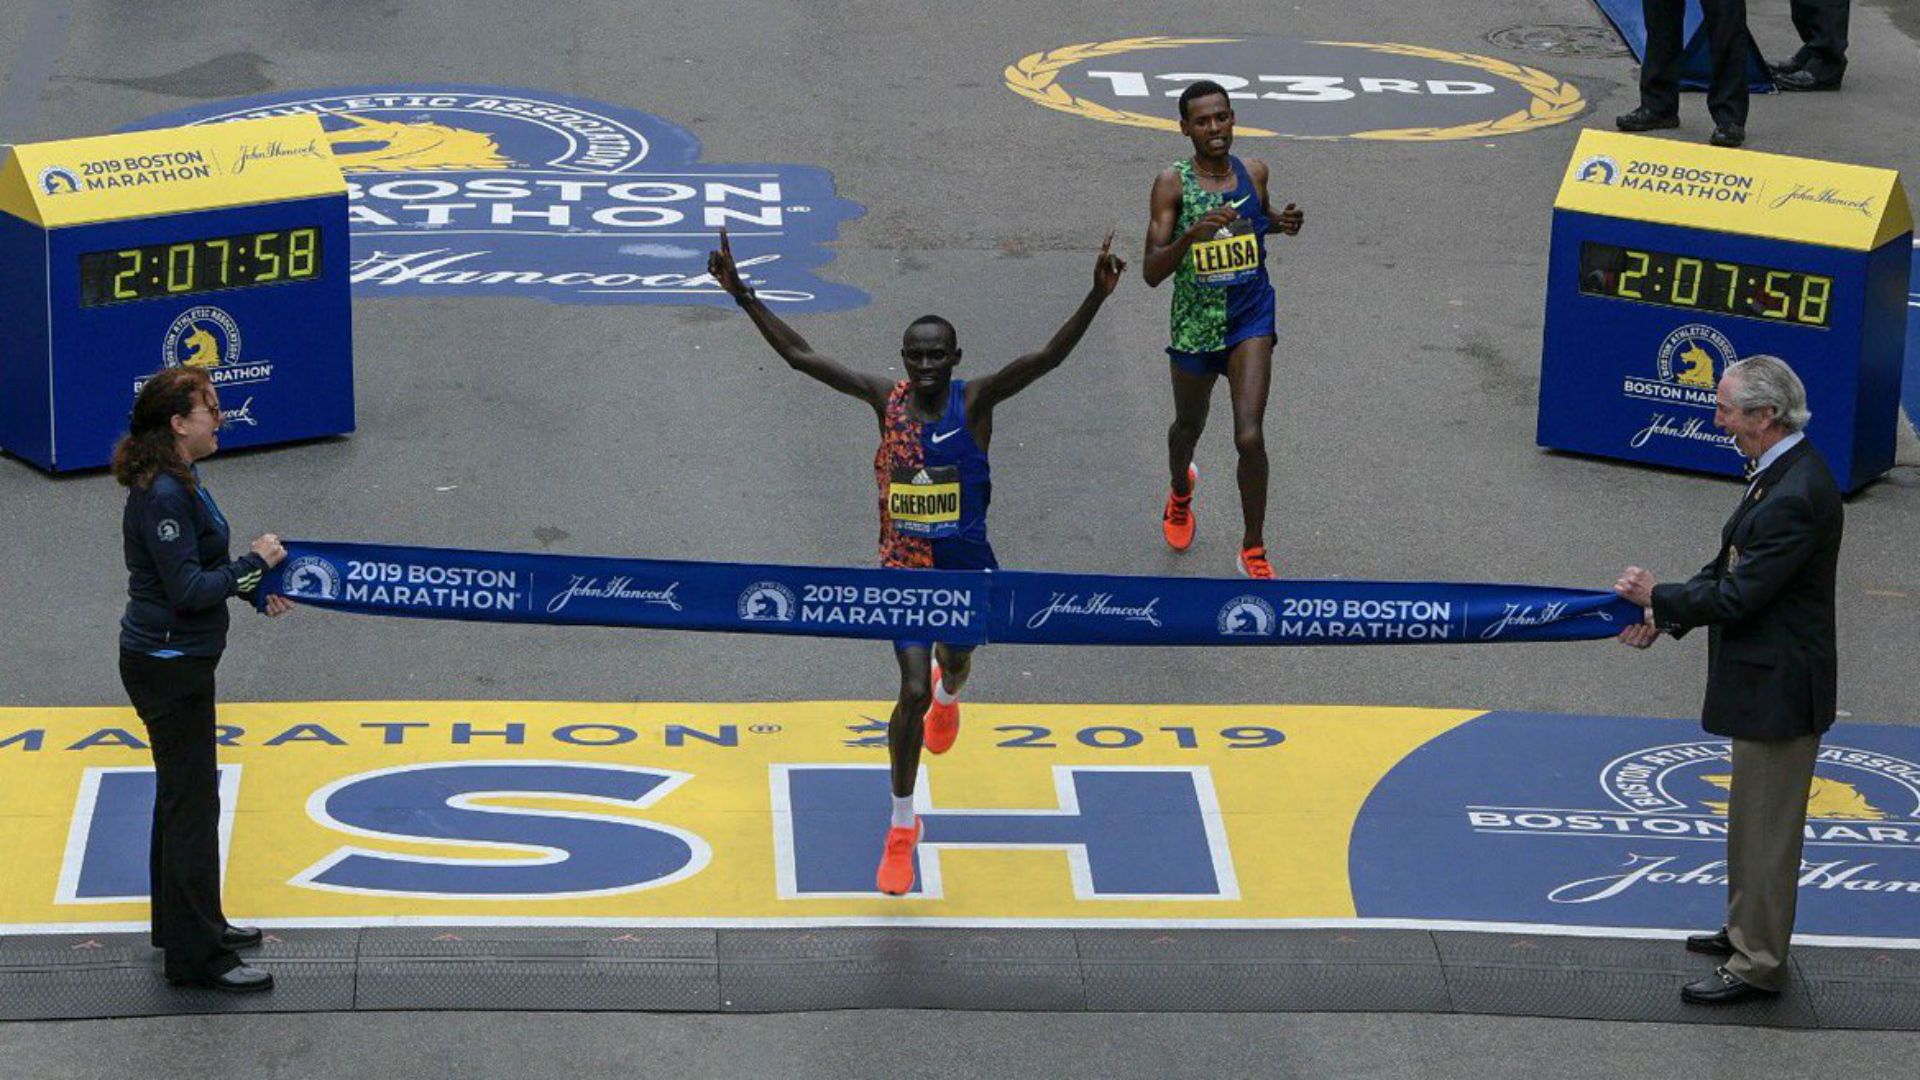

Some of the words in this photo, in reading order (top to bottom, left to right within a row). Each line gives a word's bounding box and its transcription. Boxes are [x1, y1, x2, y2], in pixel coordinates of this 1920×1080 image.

[1087, 70, 1496, 103] 123RD
[465, 99, 631, 168] ASSOCIATION
[80, 160, 121, 176] 2019
[124, 150, 204, 171] BOSTON
[232, 144, 266, 174] John
[266, 139, 326, 159] Hancock
[86, 165, 209, 191] MARATHON
[1620, 175, 1748, 205] MARATHON
[1627, 160, 1669, 177] 2019
[1671, 167, 1754, 190] BOSTON
[348, 179, 782, 202] OSTON
[114, 227, 315, 300] 2:07:58
[1195, 240, 1256, 272] LELISA
[1617, 250, 1831, 325] 2:07:58
[210, 366, 270, 383] RATHON
[1624, 380, 1682, 399] BOSTON
[1630, 412, 1679, 448] John
[891, 492, 957, 515] CHERONO
[347, 560, 402, 582] 2019
[408, 565, 516, 588] BOSTON
[346, 583, 516, 611] MARATHON
[547, 574, 601, 614] John
[601, 574, 683, 612] Hancock
[803, 584, 858, 603] 2019
[864, 587, 971, 607] BOSTON
[801, 605, 971, 628] MARATHON
[1026, 592, 1081, 629] John
[1081, 591, 1163, 628] Hancock
[1282, 598, 1338, 618] 2019
[1343, 600, 1451, 621] BOSTON
[1480, 603, 1538, 639] John
[1281, 620, 1450, 639] MARATHON
[995, 725, 1287, 750] 2019
[1615, 762, 1667, 807] BOSTON
[1641, 746, 1733, 766] ATHL
[54, 759, 1241, 905] ISH
[1467, 811, 1728, 836] BOSTON
[1548, 852, 1728, 903] Joh
